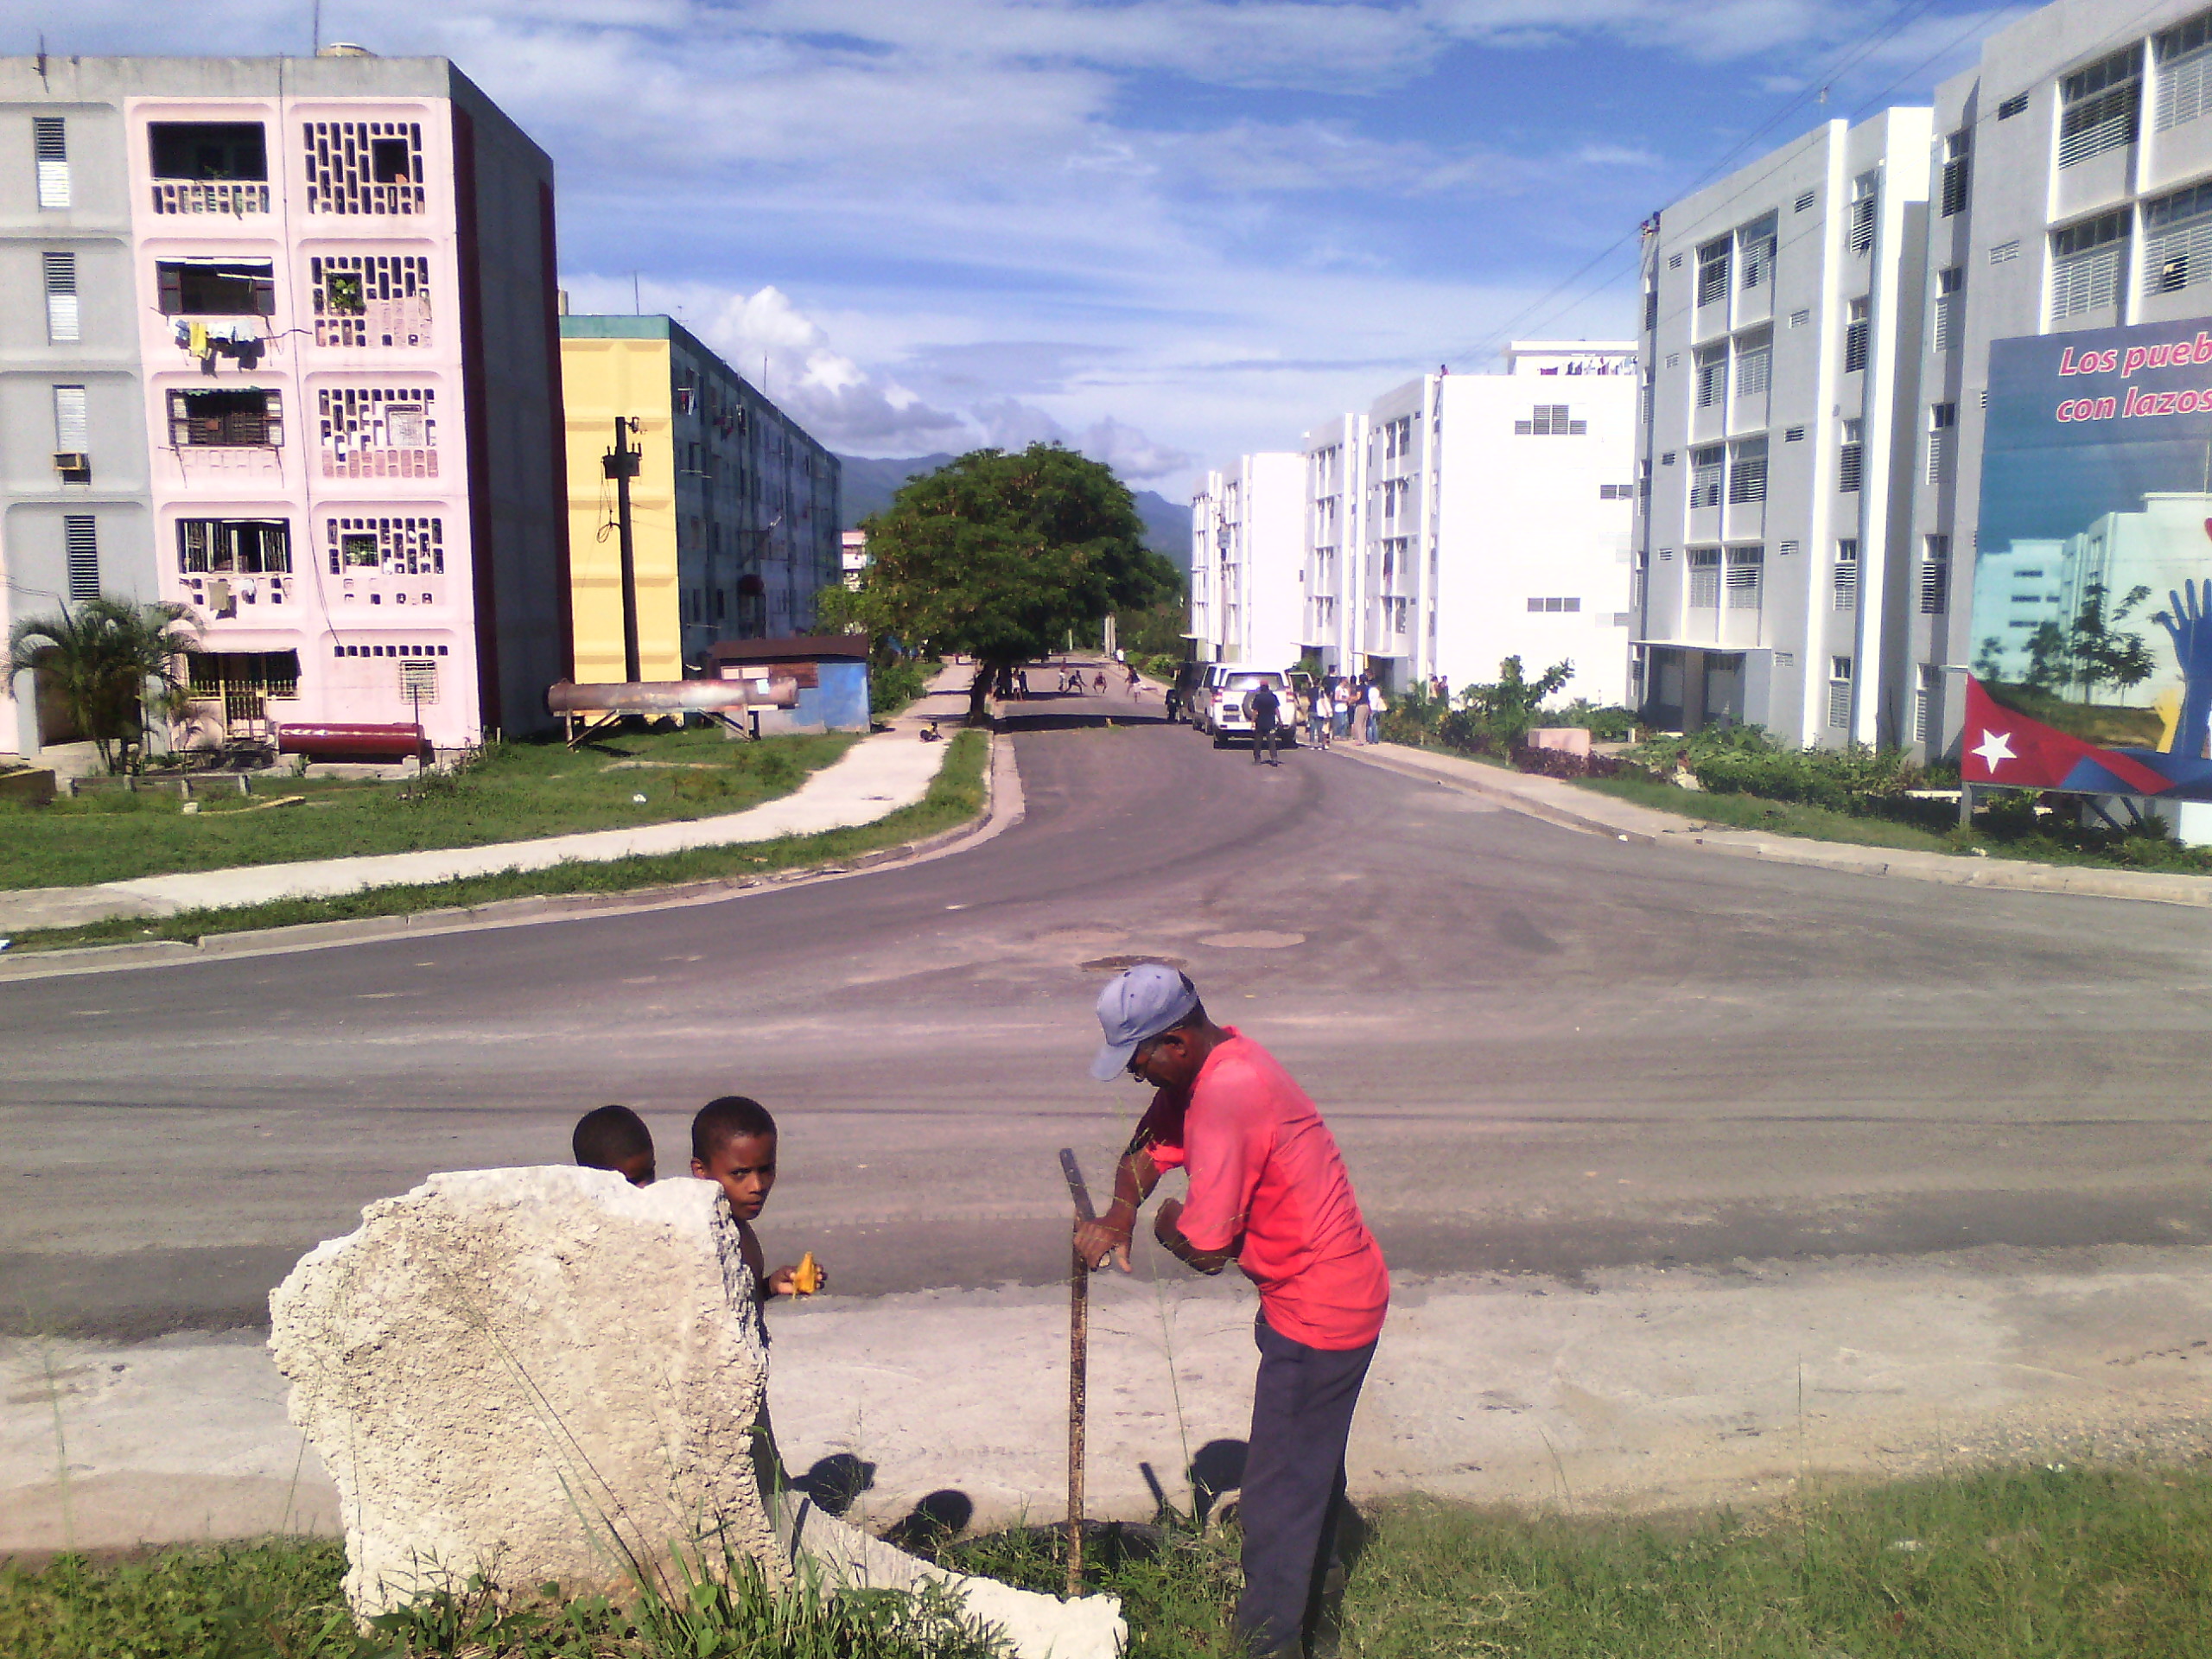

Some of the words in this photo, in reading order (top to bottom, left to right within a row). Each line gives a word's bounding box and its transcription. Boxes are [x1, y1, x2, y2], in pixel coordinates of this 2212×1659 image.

[2059, 346, 2118, 376] Los
[2120, 331, 2212, 378] pueb
[2056, 397, 2115, 422] con
[2122, 386, 2212, 418] lazos
